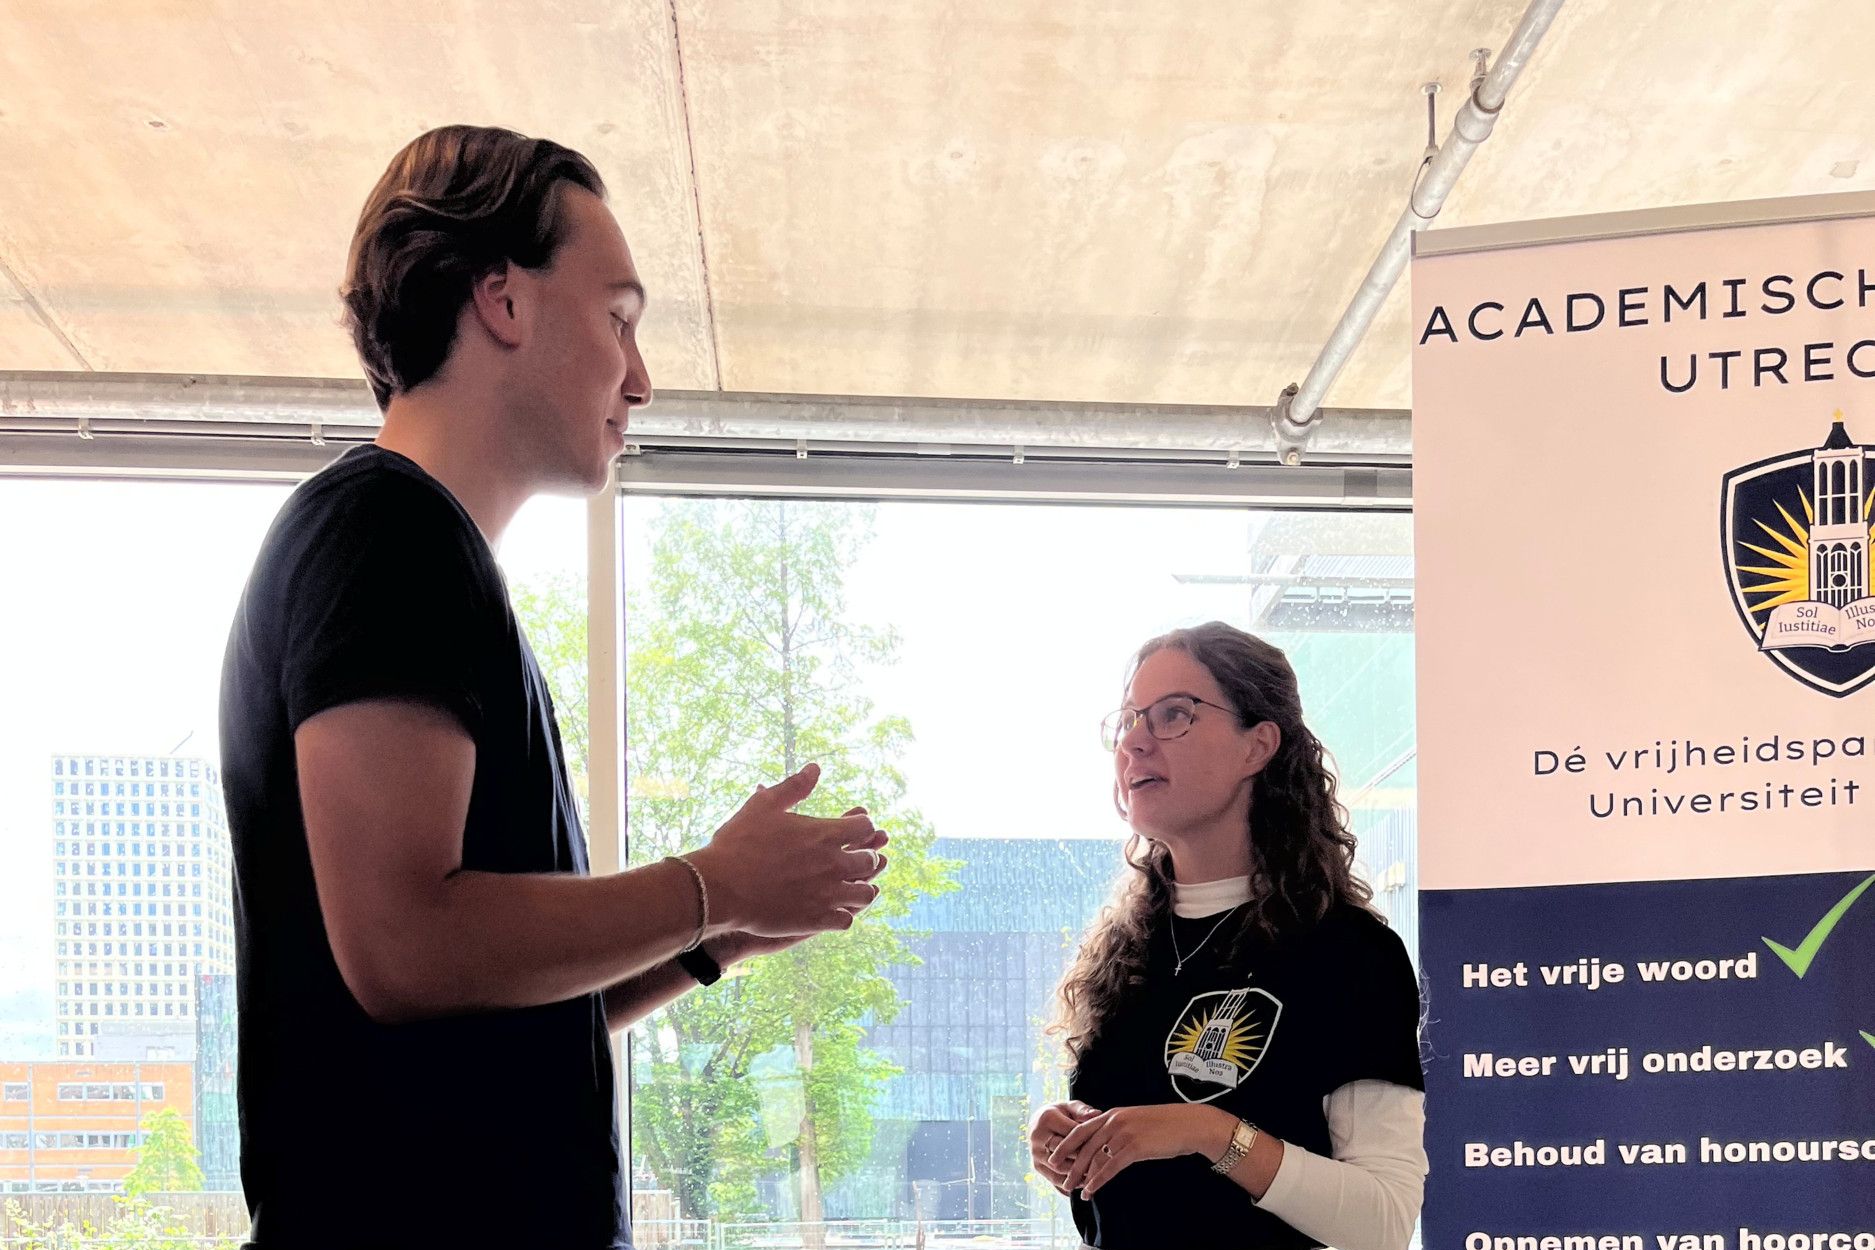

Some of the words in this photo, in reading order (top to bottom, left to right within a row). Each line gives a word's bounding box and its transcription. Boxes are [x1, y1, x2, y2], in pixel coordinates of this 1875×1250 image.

[1778, 619, 1836, 635] Iustitiae
[1796, 606, 1818, 619] Sol
[1533, 745, 1587, 776] Dé
[1606, 735, 1875, 774] vrijheidspa
[1589, 778, 1860, 818] Universiteit
[1462, 961, 1528, 988] Het
[1539, 957, 1625, 990] vrije
[1637, 952, 1757, 982] woord
[1463, 1052, 1557, 1078] Meer
[1568, 1047, 1629, 1081] vrij
[1641, 1042, 1847, 1073] onderzoek
[1463, 1140, 1605, 1167] Behoud
[1618, 1142, 1686, 1165] van
